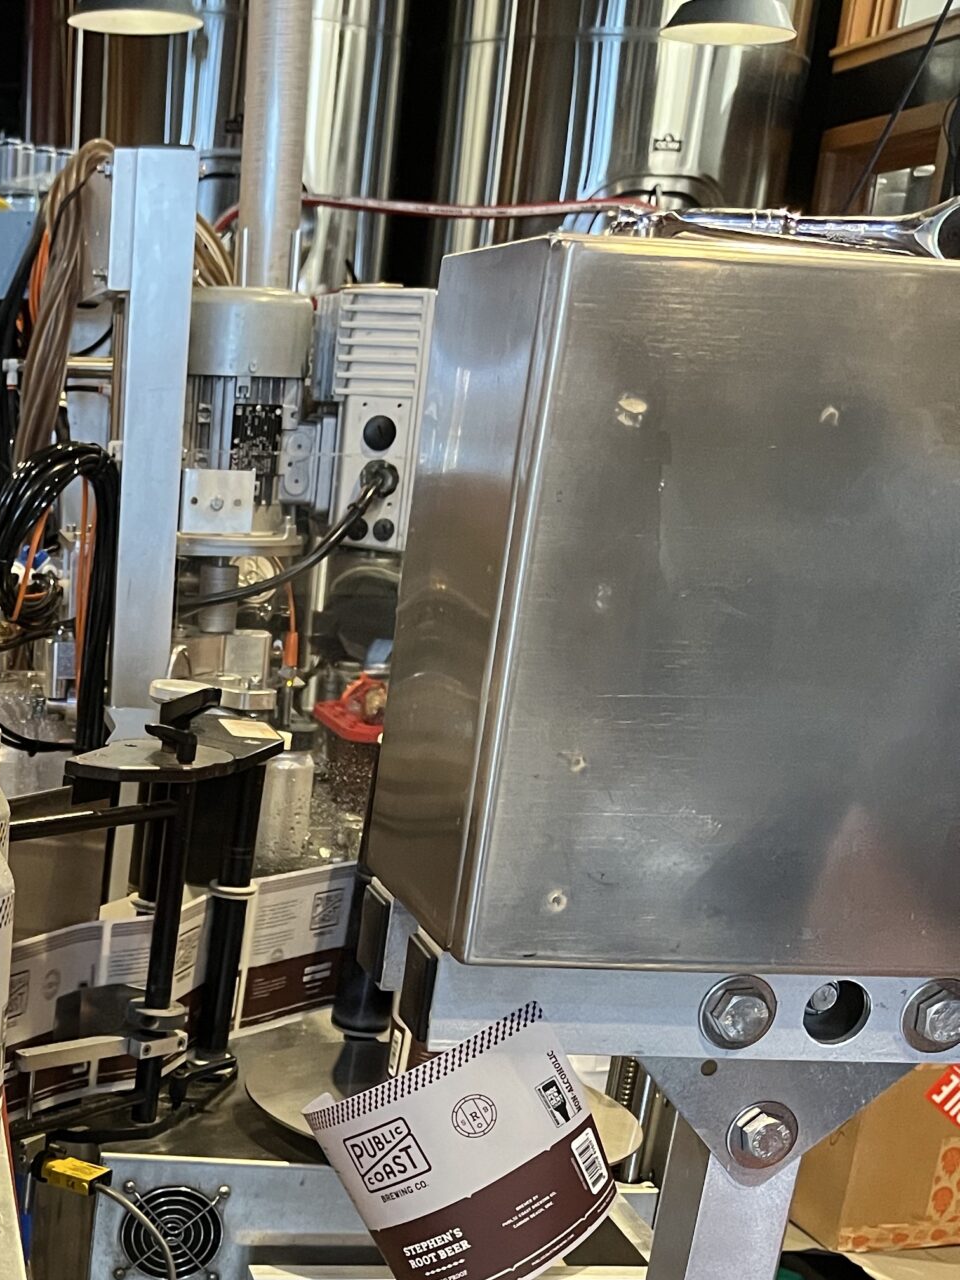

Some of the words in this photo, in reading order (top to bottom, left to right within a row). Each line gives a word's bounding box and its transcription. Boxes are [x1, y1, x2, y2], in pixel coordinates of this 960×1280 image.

[350, 1125, 403, 1169] PUBLIC
[367, 1145, 418, 1186] COAST
[380, 1185, 414, 1203] BREWING
[414, 1179, 430, 1191] CO.
[403, 1227, 463, 1257] STEPHEN'S
[408, 1252, 438, 1269] ROOT
[437, 1239, 472, 1260] BEER
